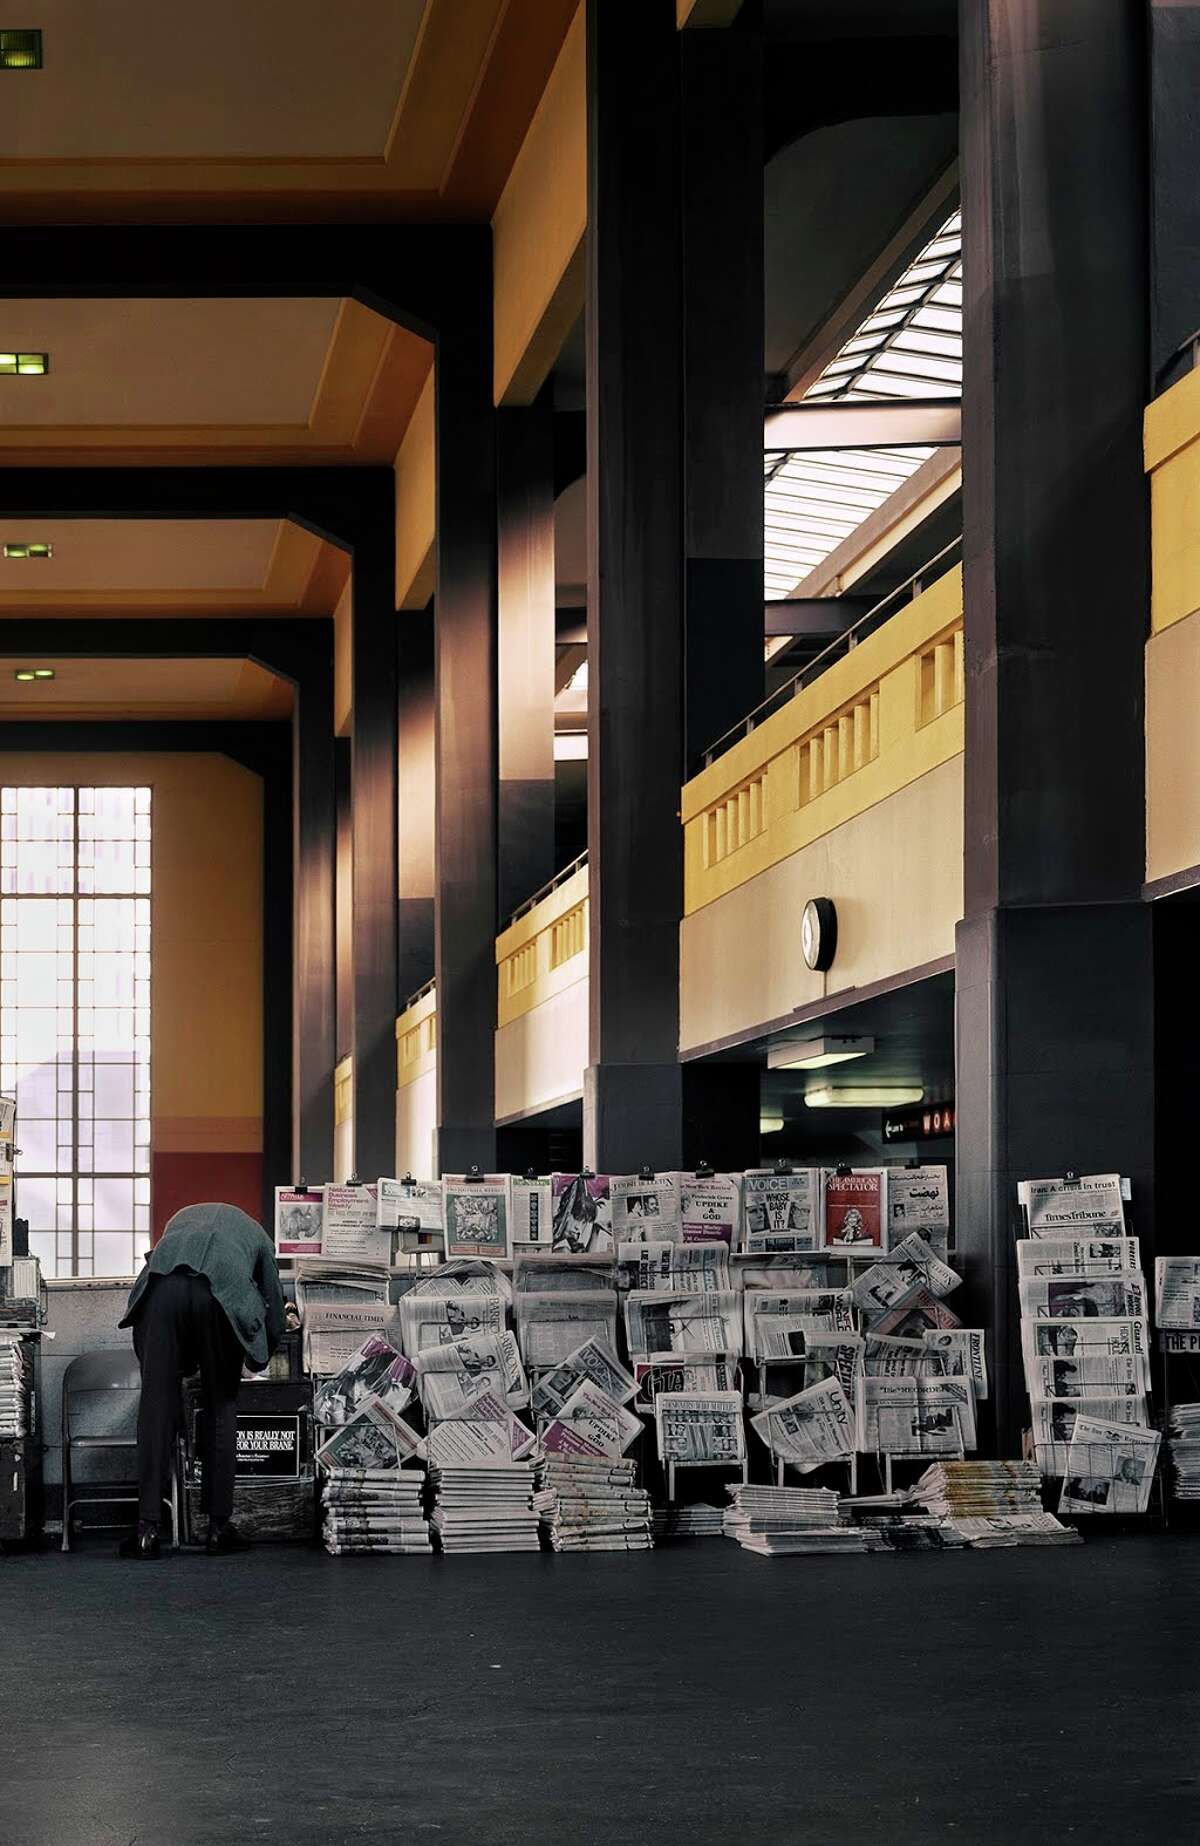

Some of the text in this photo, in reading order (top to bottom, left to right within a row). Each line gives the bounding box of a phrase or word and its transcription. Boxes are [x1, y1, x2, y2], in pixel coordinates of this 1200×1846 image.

[747, 1179, 788, 1190] VOICE
[828, 1183, 879, 1191] SPECTATOR
[1095, 1181, 1116, 1189] trust
[766, 1193, 790, 1202] WHOSE
[769, 1202, 788, 1211] BABY
[775, 1211, 783, 1220] IS
[325, 1313, 363, 1321] FINANCIAL
[1166, 1333, 1186, 1350] THE
[247, 1430, 254, 1440] IS
[254, 1430, 279, 1440] REALLY
[281, 1430, 296, 1441] NOT
[250, 1440, 269, 1450] YOUR
